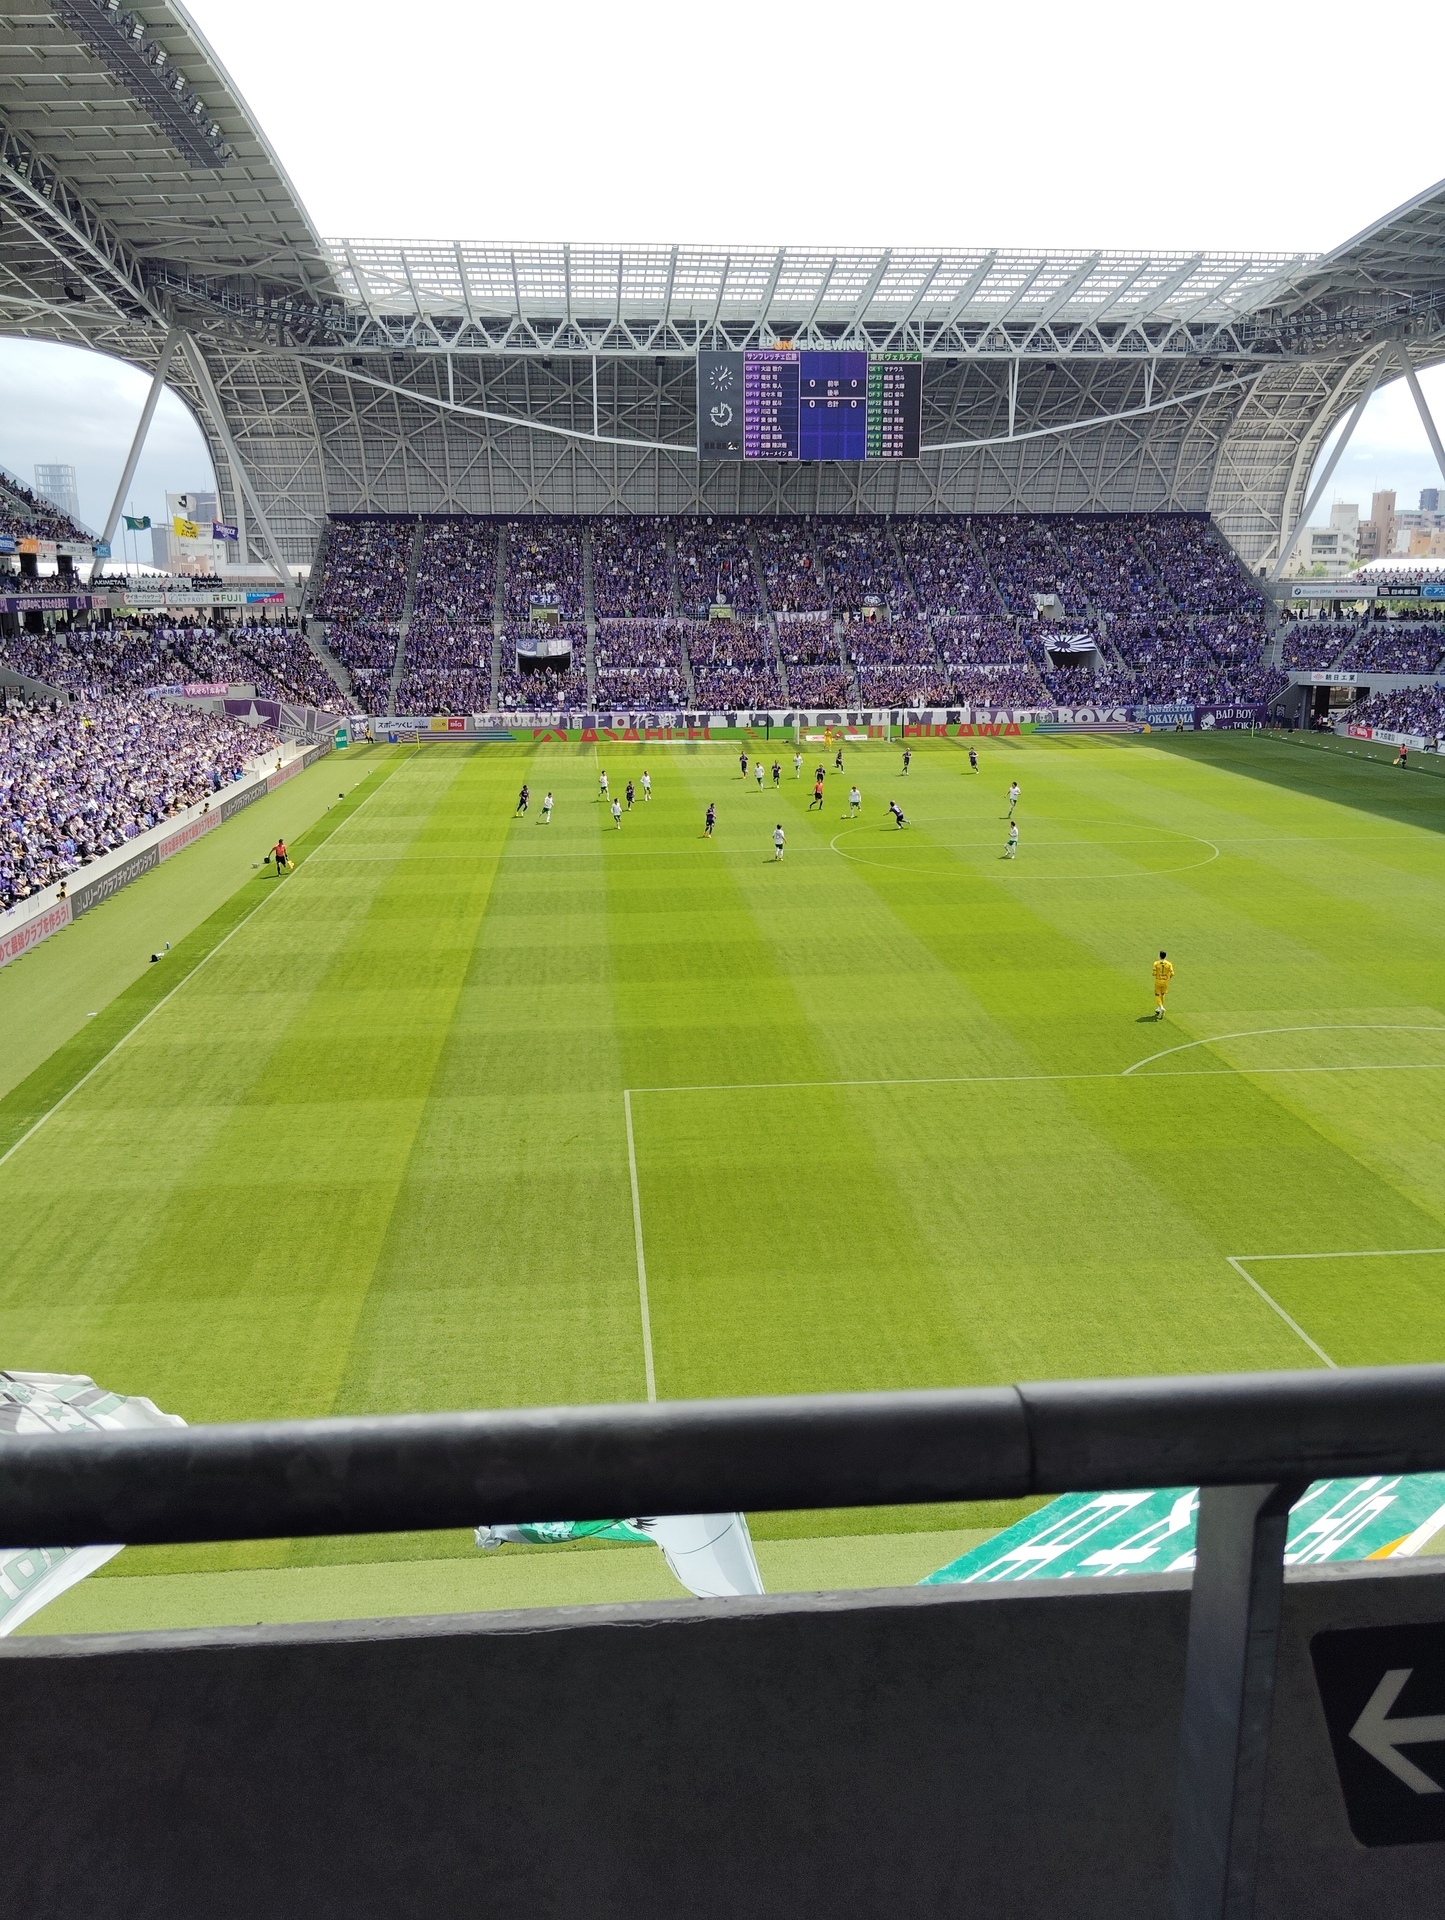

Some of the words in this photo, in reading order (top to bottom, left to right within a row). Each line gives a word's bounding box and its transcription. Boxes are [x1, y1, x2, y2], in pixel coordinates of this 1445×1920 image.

[793, 340, 830, 350] PEACE
[831, 340, 864, 350] WING
[870, 353, 919, 361] 東京ヴェルディ
[221, 594, 242, 602] FUJI
[975, 710, 1031, 724] BAD
[1058, 708, 1128, 724] BOYS
[1147, 714, 1194, 724] OKAYAMA
[1215, 709, 1234, 720] BAD
[378, 721, 413, 730] スポーツくじ
[475, 714, 494, 727] EL
[632, 713, 677, 730] 作戦
[285, 726, 336, 744] HIROSHIMA
